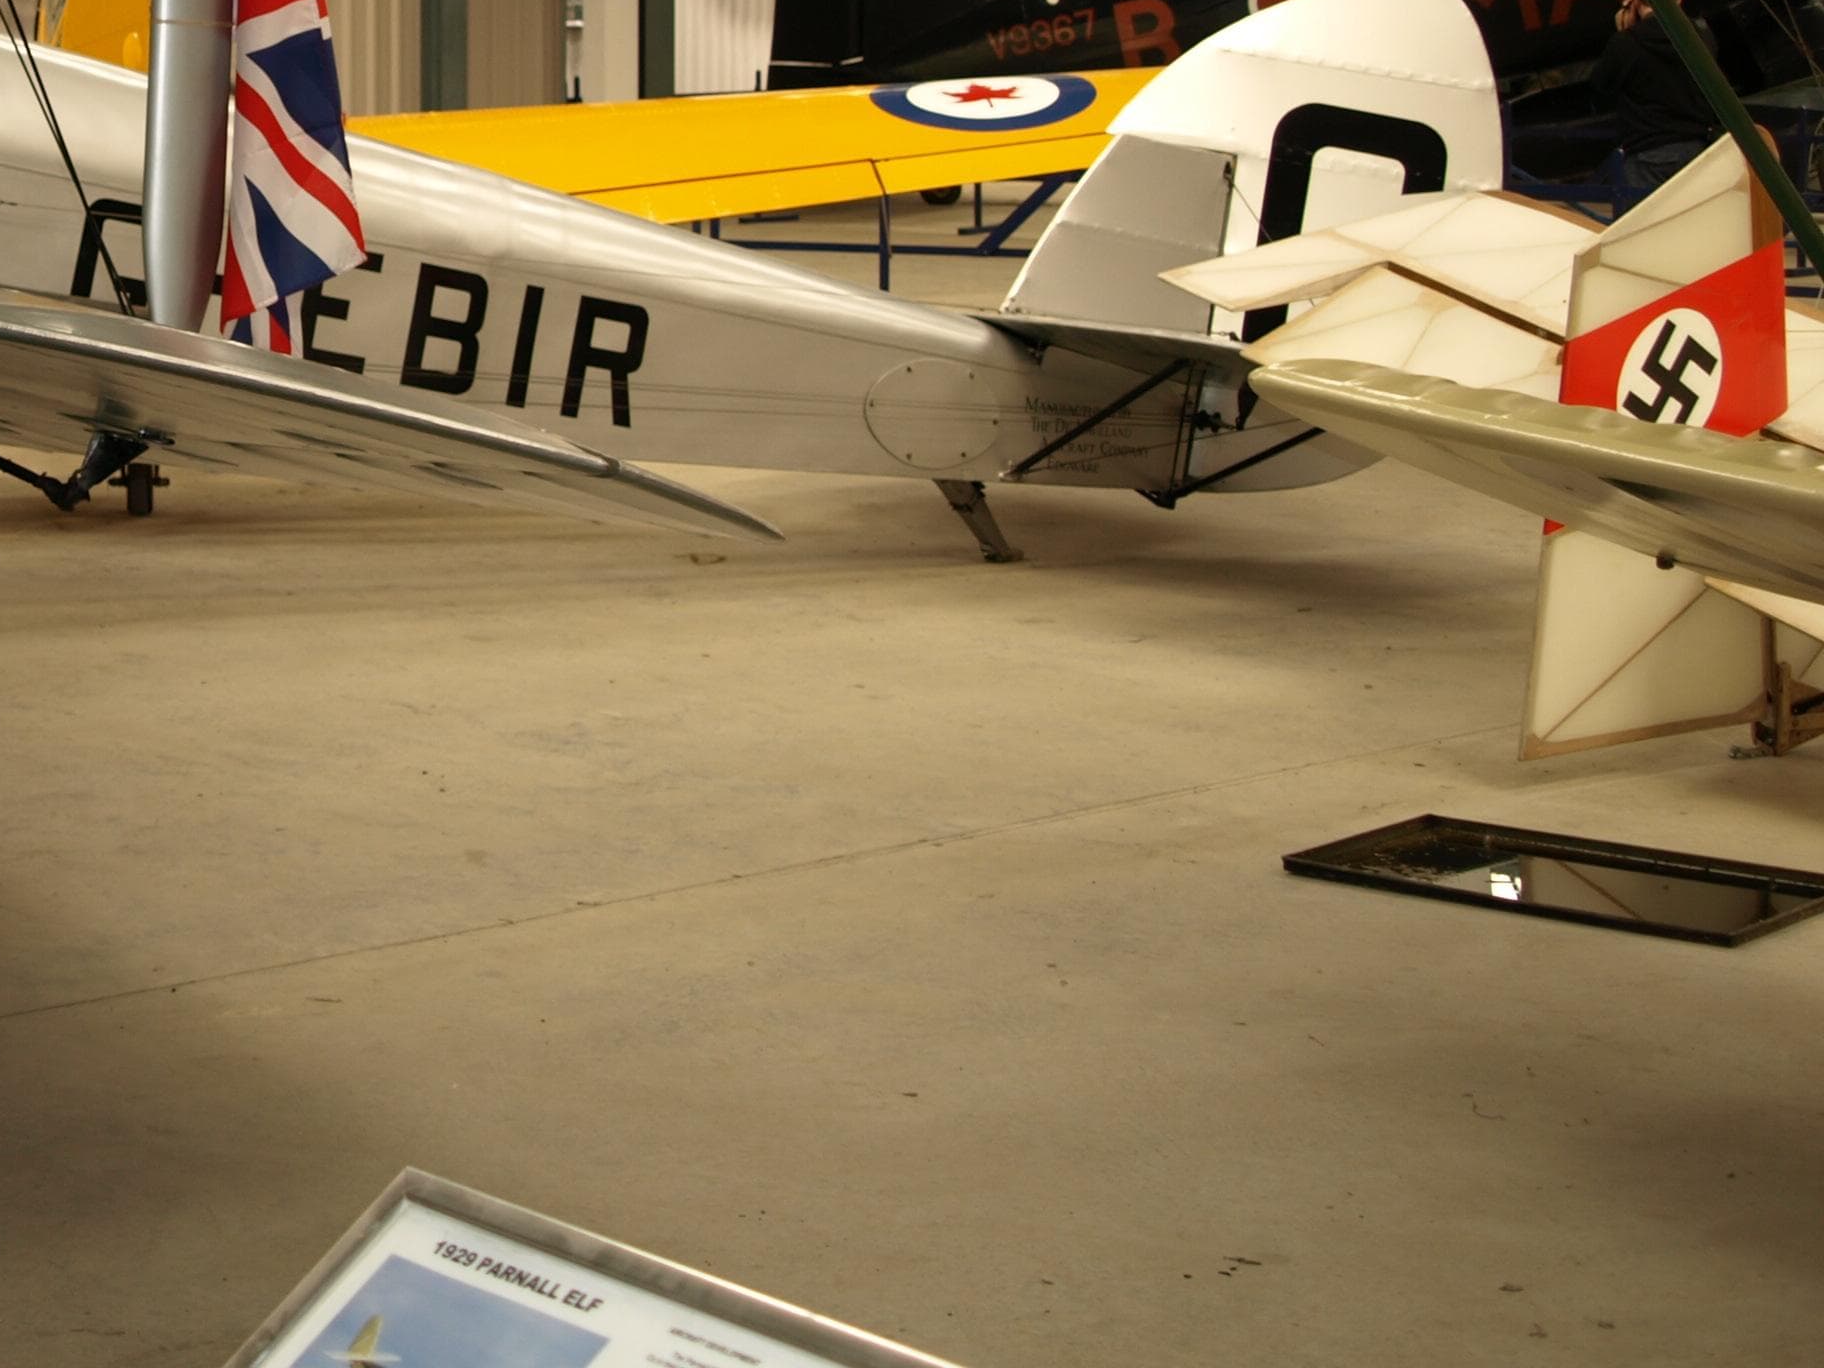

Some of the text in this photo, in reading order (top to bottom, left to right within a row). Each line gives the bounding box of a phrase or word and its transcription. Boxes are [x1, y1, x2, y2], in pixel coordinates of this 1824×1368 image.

[987, 7, 1097, 62] V9367
[71, 198, 649, 428] GEBIR
[433, 1240, 605, 1313] 1929 PARNALL ELF
